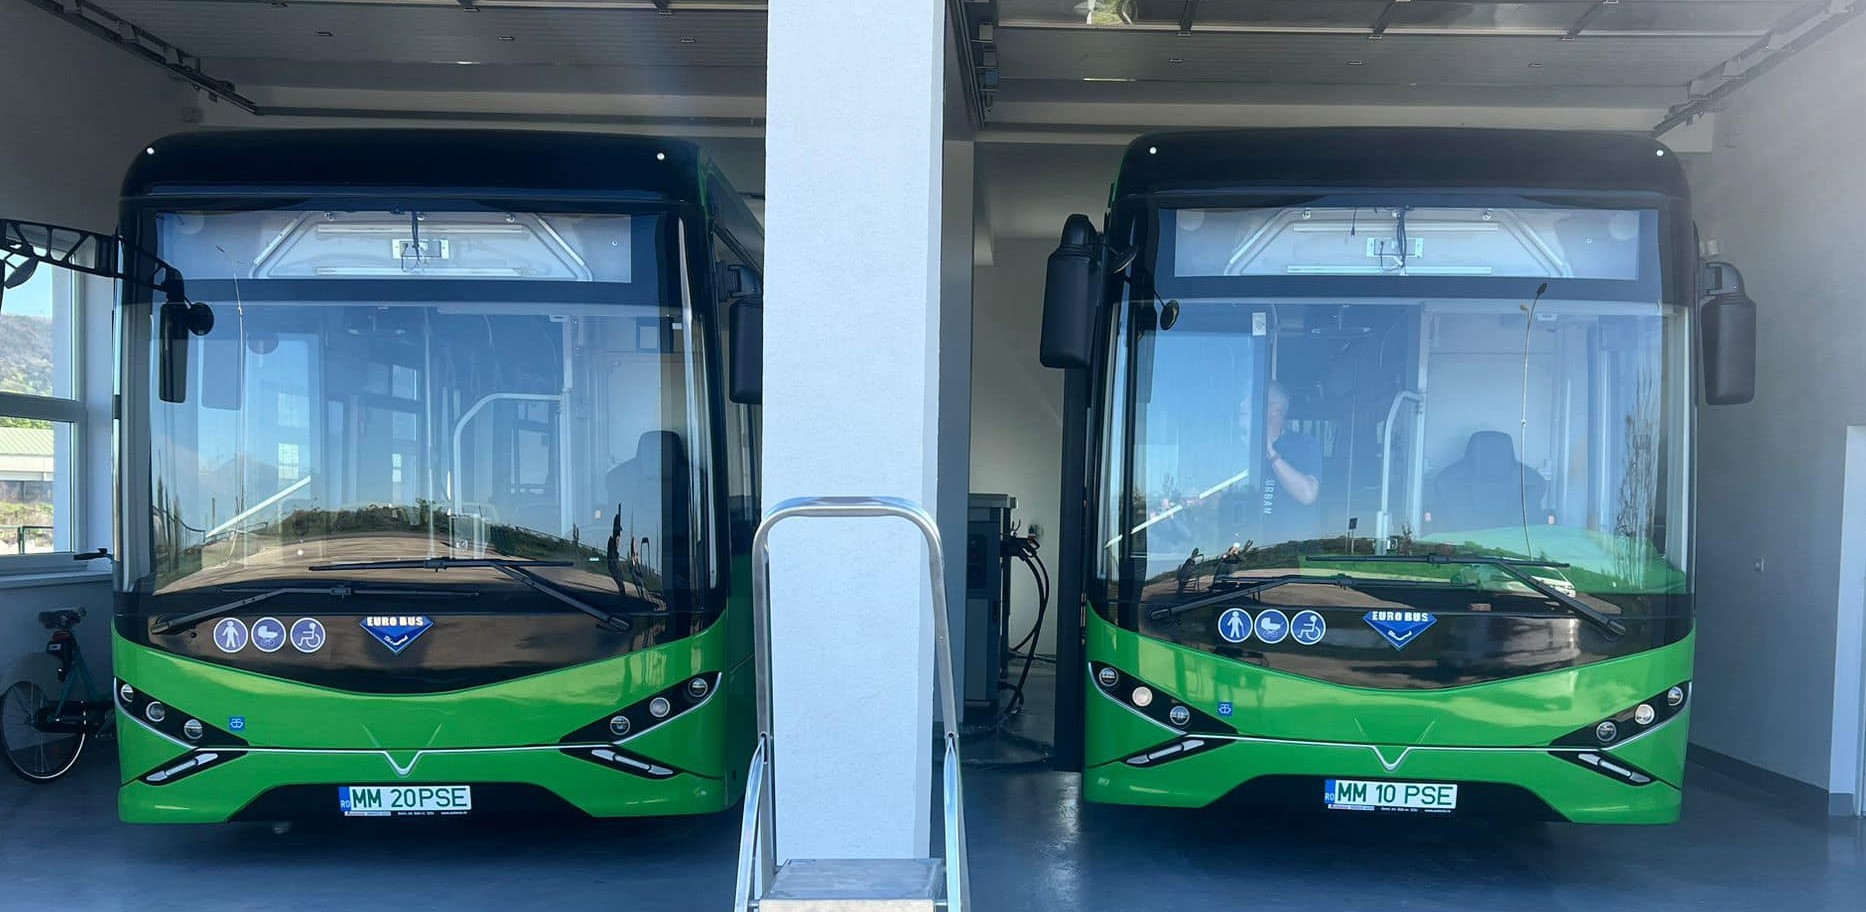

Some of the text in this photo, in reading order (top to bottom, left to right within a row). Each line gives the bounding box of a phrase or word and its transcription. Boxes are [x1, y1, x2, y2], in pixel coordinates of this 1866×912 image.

[1264, 480, 1275, 514] URBAN
[367, 616, 423, 626] EURO BUS
[1372, 611, 1428, 622] EURO BUS
[352, 788, 382, 808] MM
[1338, 782, 1453, 805] MM 10 PSE
